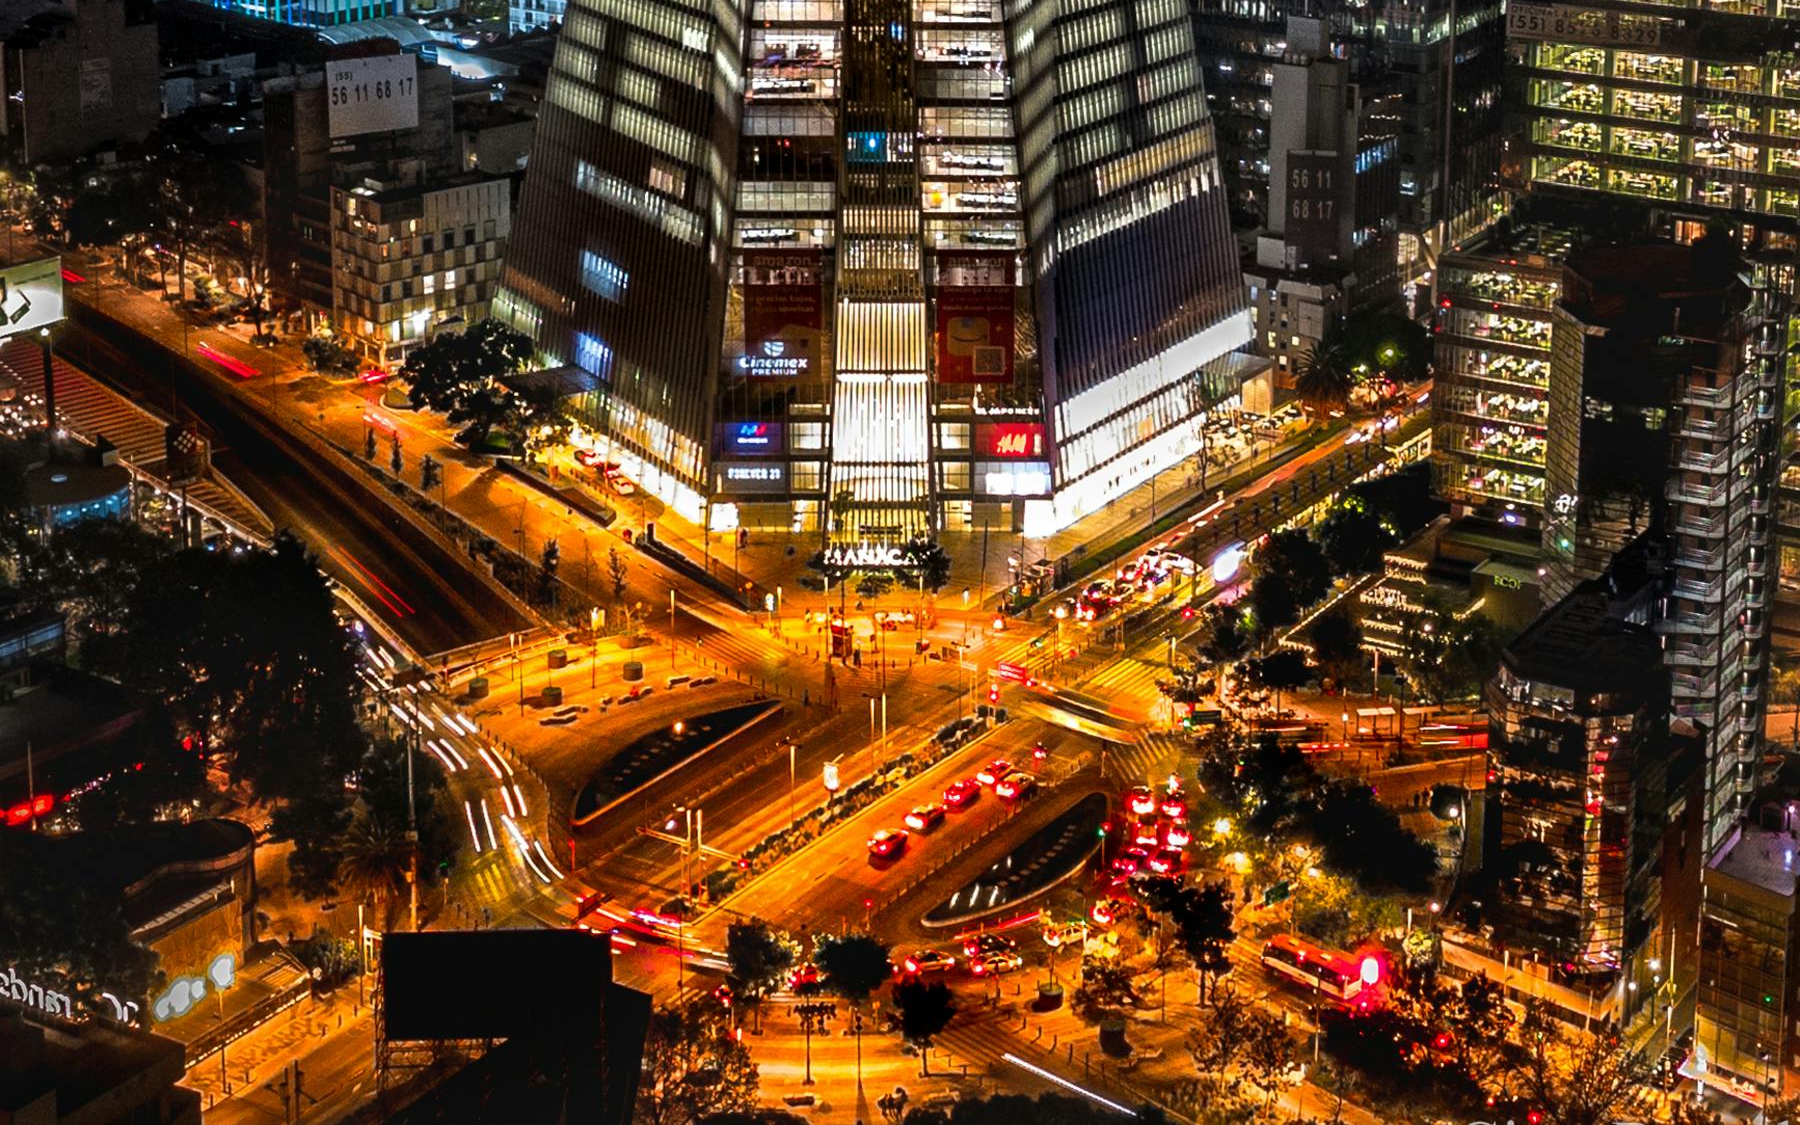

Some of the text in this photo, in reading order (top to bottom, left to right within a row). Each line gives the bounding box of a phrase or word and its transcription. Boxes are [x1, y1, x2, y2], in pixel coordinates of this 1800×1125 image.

[332, 77, 413, 106] 56 11 68 17
[1292, 168, 1331, 189] 56 11
[1292, 199, 1334, 220] 68 17
[739, 356, 808, 369] Cinemex
[752, 368, 798, 376] PREMIUM
[824, 548, 929, 566] MANACA
